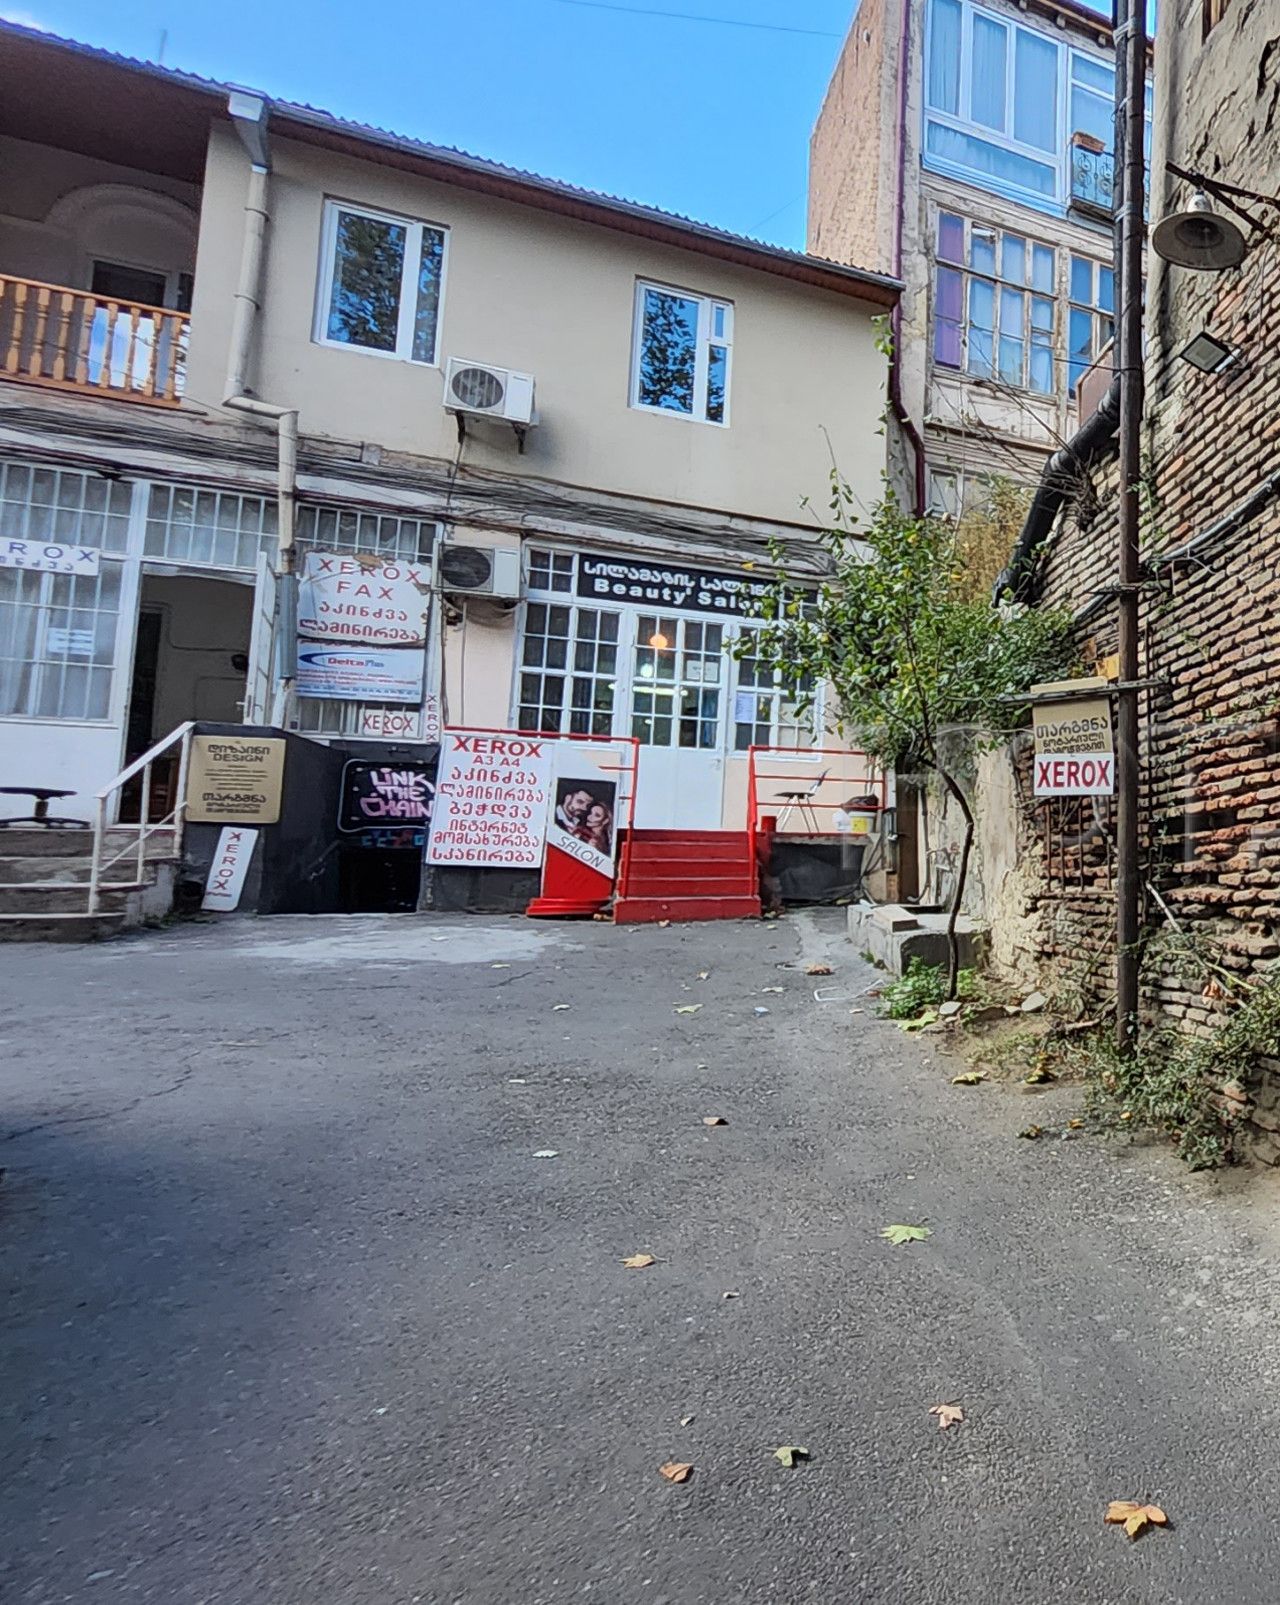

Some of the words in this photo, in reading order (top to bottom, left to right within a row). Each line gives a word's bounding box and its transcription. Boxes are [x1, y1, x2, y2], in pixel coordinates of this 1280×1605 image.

[318, 558, 421, 585] XEROX
[584, 561, 696, 588] სილამაზის
[336, 580, 395, 601] FAX
[319, 601, 408, 621] აკინძვა
[299, 618, 420, 640] ლამინირება
[363, 714, 414, 732] XEROX
[426, 694, 439, 741] XEROX
[1036, 716, 1109, 739] თარგმნა
[452, 735, 545, 759] XEROX
[213, 754, 264, 763] DESIGN
[472, 754, 494, 766] A3
[501, 756, 521, 767] A4
[451, 766, 538, 786] აკინძვა
[1037, 760, 1111, 788] XEROX
[376, 785, 426, 802] THE
[440, 782, 544, 803] ლამინირება
[449, 800, 533, 819] ბეჭდვა
[449, 819, 529, 835] ინტერნეტ
[213, 831, 243, 890] XEROX
[431, 847, 536, 863] სკანირება
[557, 836, 605, 869] SALON
